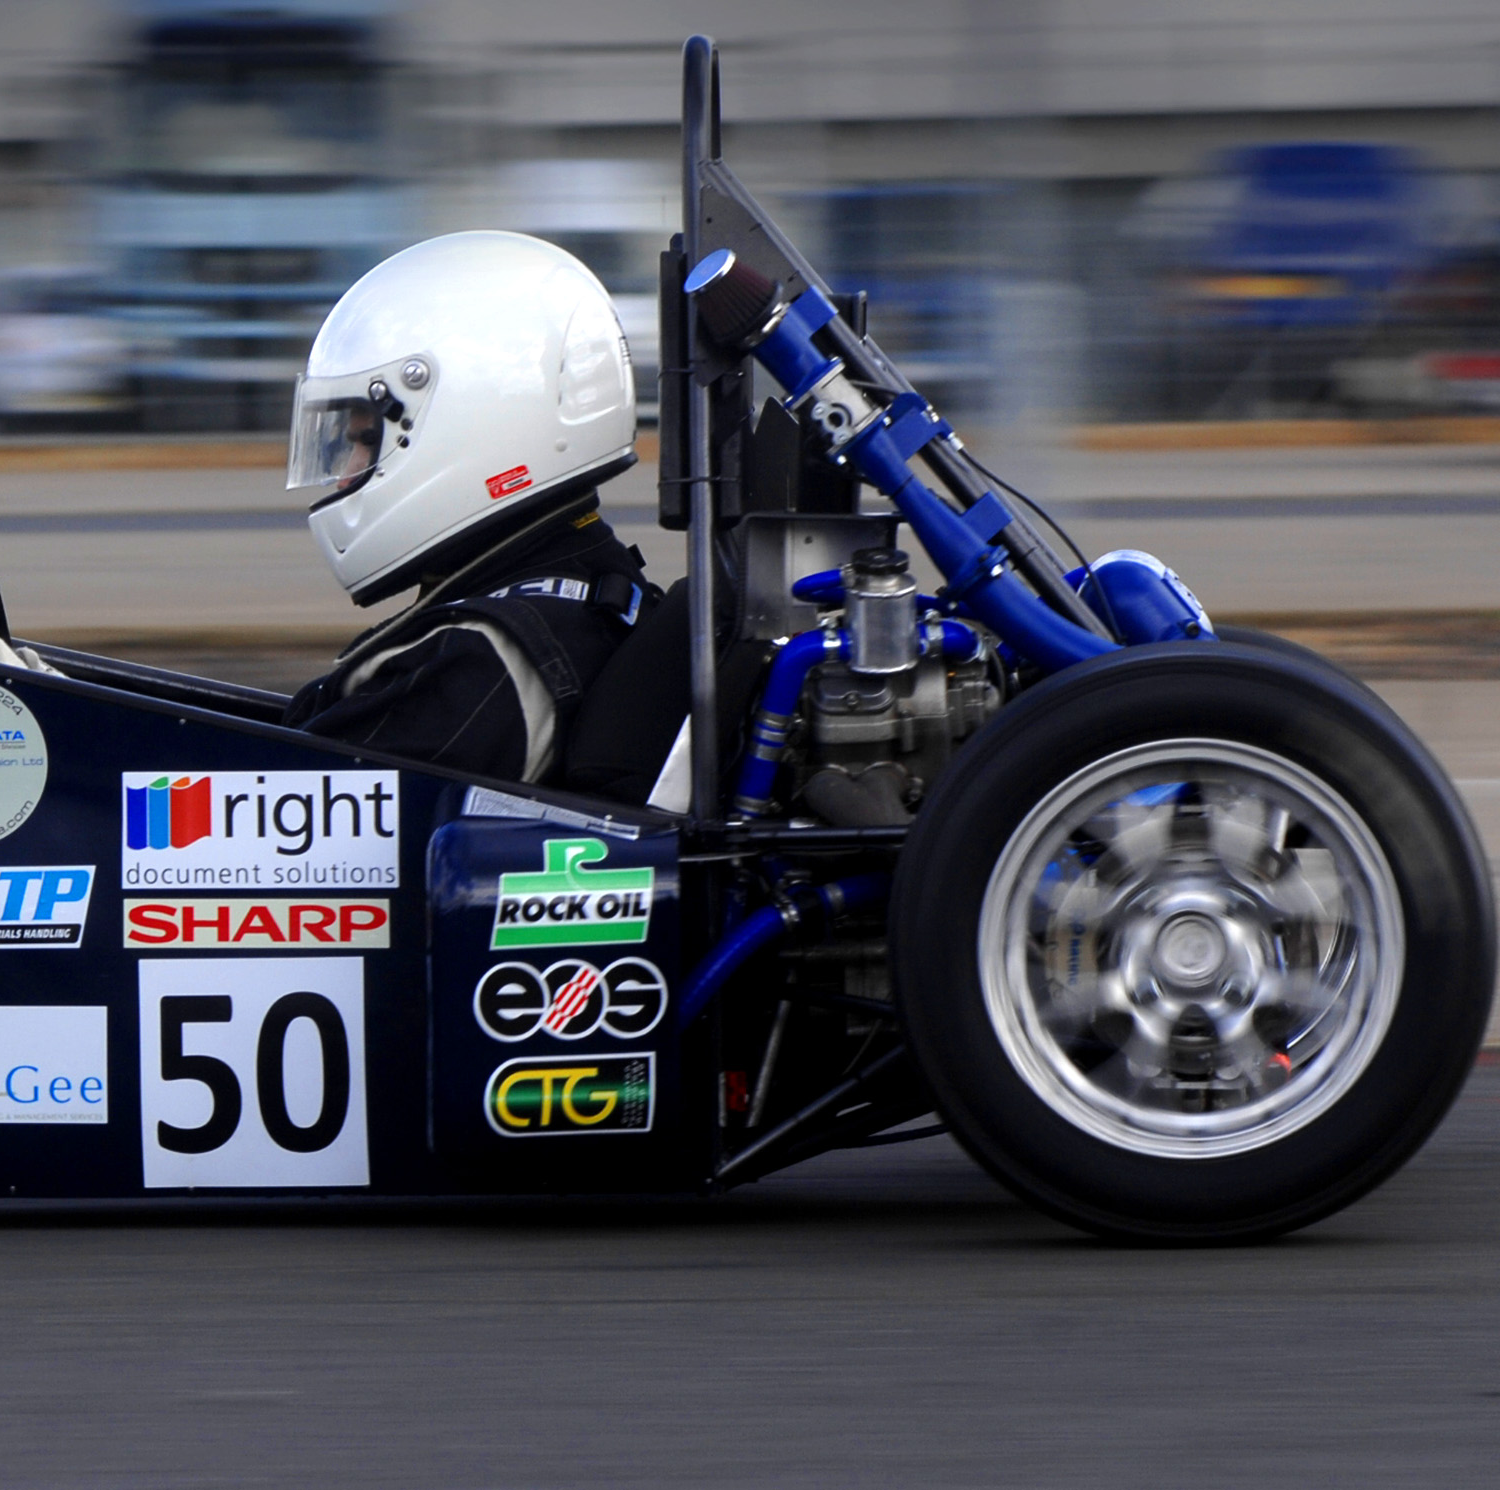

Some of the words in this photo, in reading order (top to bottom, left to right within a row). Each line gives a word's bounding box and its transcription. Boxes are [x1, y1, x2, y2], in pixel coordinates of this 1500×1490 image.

[23, 757, 44, 766] Ltd
[224, 775, 395, 856] right
[126, 862, 262, 885] document
[273, 861, 396, 884] solutions
[128, 904, 388, 944] SHARP
[498, 894, 592, 924] ROCK
[595, 890, 648, 920] OIL
[23, 928, 71, 939] HANDLING
[157, 991, 350, 1155] 50
[496, 1067, 619, 1128] CTG
